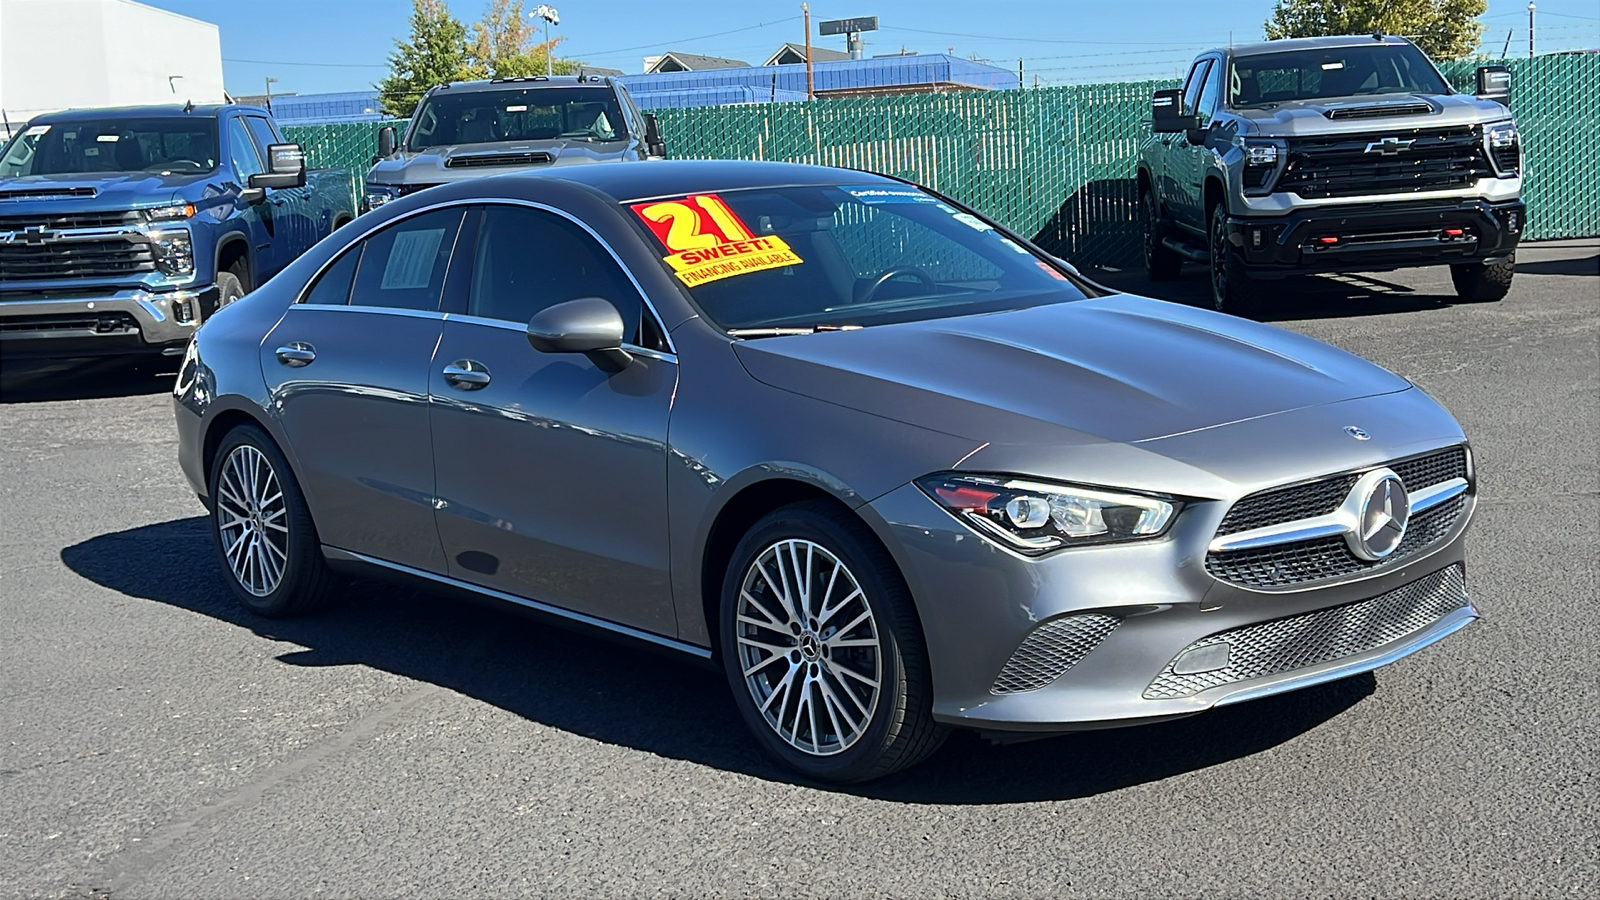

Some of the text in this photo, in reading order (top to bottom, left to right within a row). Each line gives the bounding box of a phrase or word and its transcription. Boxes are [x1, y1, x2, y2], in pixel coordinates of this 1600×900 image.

[641, 196, 747, 250] 21
[680, 238, 773, 265] SWEET!
[682, 253, 795, 284] FINANCING AVAILABLE
